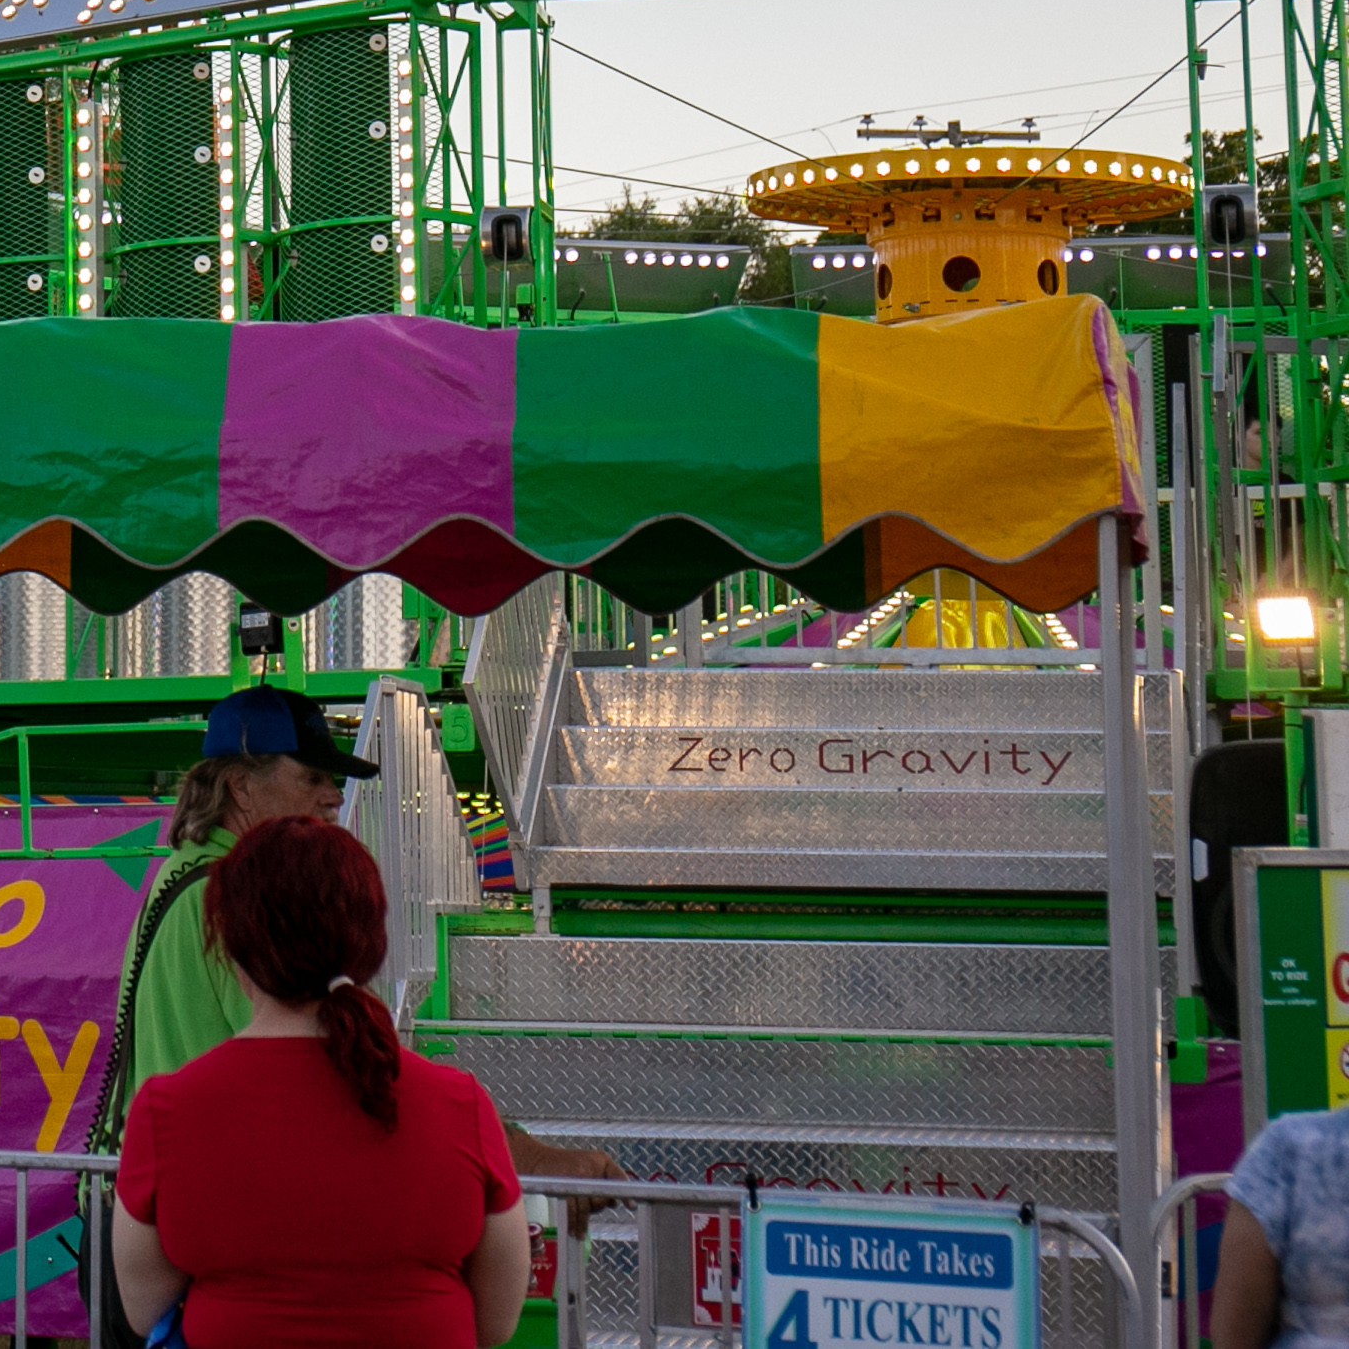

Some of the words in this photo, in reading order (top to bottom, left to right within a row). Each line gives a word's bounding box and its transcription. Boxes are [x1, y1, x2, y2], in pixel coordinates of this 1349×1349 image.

[450, 714, 469, 743] 5
[668, 736, 796, 772] Zero
[818, 738, 1072, 785] Gravity
[1270, 971, 1285, 981] TO
[1286, 971, 1309, 981] RIDE
[1281, 958, 1297, 969] OK
[784, 1233, 841, 1268] This
[850, 1237, 911, 1272] Ride
[918, 1241, 995, 1277] Takes
[766, 1290, 818, 1349] 4
[823, 1297, 1002, 1349] TICKETS
